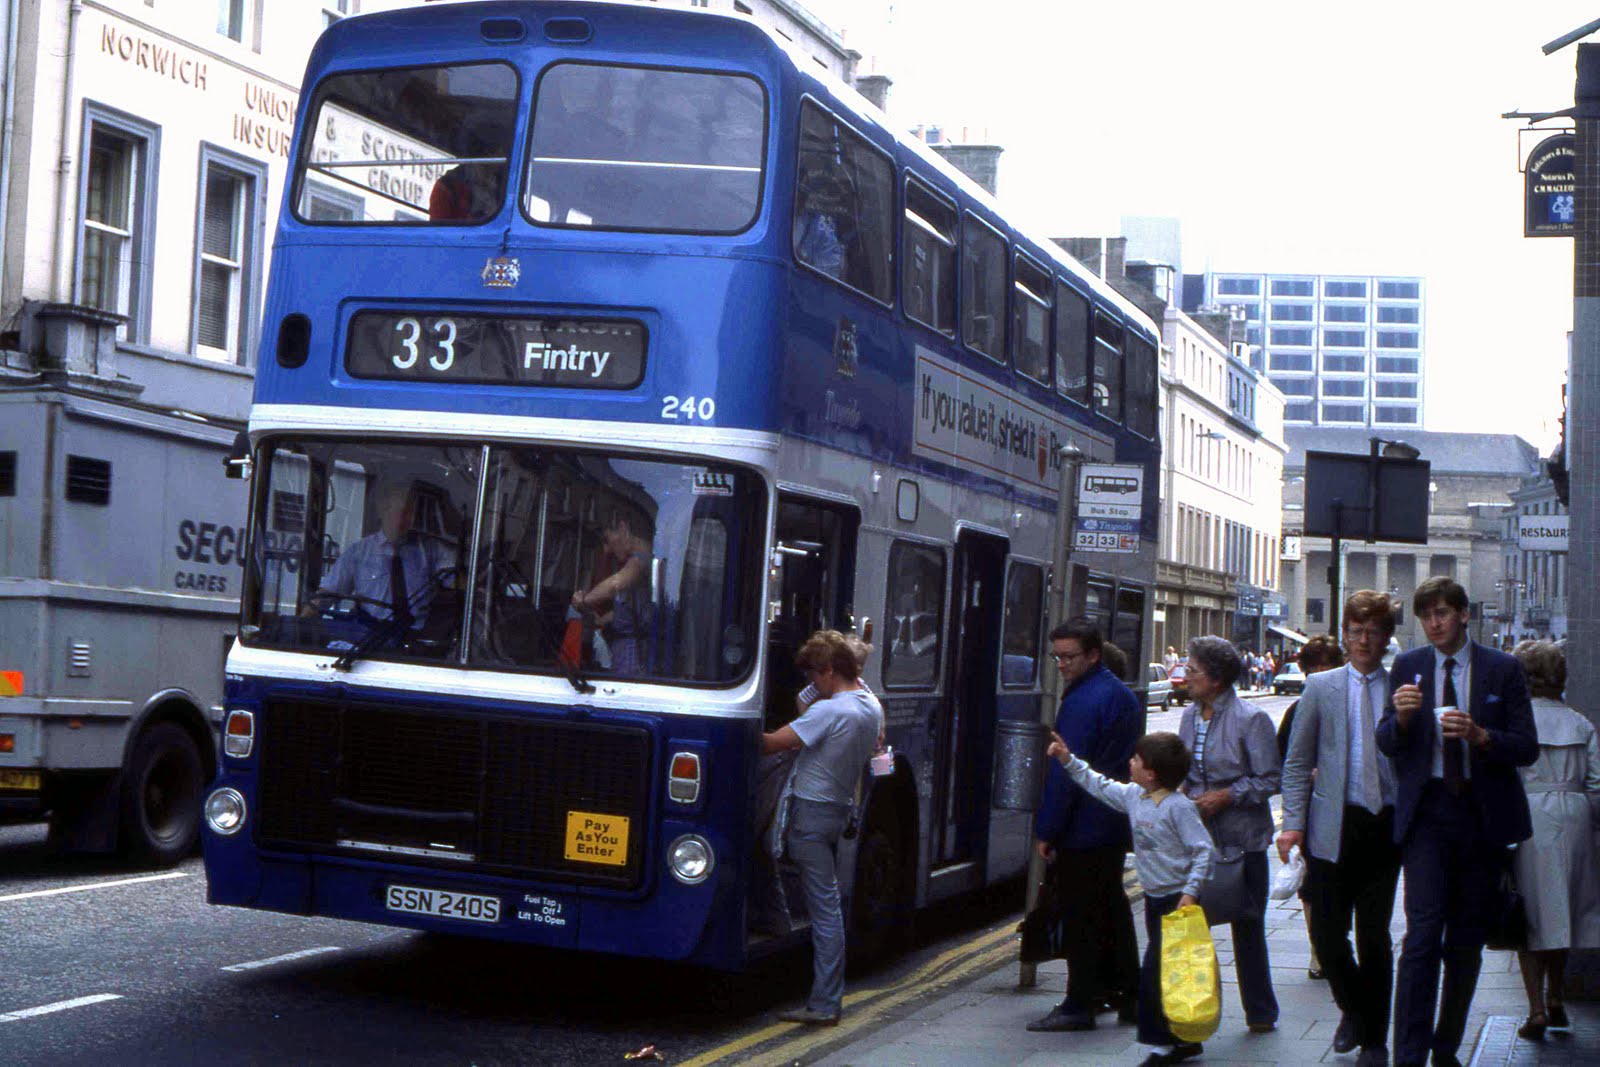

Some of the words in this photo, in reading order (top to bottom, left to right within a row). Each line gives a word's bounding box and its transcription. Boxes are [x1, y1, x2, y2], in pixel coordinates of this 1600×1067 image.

[102, 24, 207, 91] NORWICH
[368, 168, 424, 203] GROUP
[523, 342, 610, 378] Fintry
[661, 396, 716, 421] 240
[932, 389, 956, 434] you
[1090, 506, 1105, 515] Bus
[1109, 507, 1129, 516] Stop
[1080, 535, 1094, 545] 32
[1100, 536, 1116, 546] 33
[175, 571, 227, 593] CARES
[584, 818, 610, 833] Pay
[576, 831, 592, 842] As
[593, 832, 618, 845] You
[577, 843, 614, 857] Enter
[389, 887, 433, 912] SSN
[438, 894, 498, 920] 240S
[524, 894, 540, 904] Fuel
[542, 897, 556, 907] Tap
[533, 913, 543, 922] To
[544, 915, 566, 925] Open
